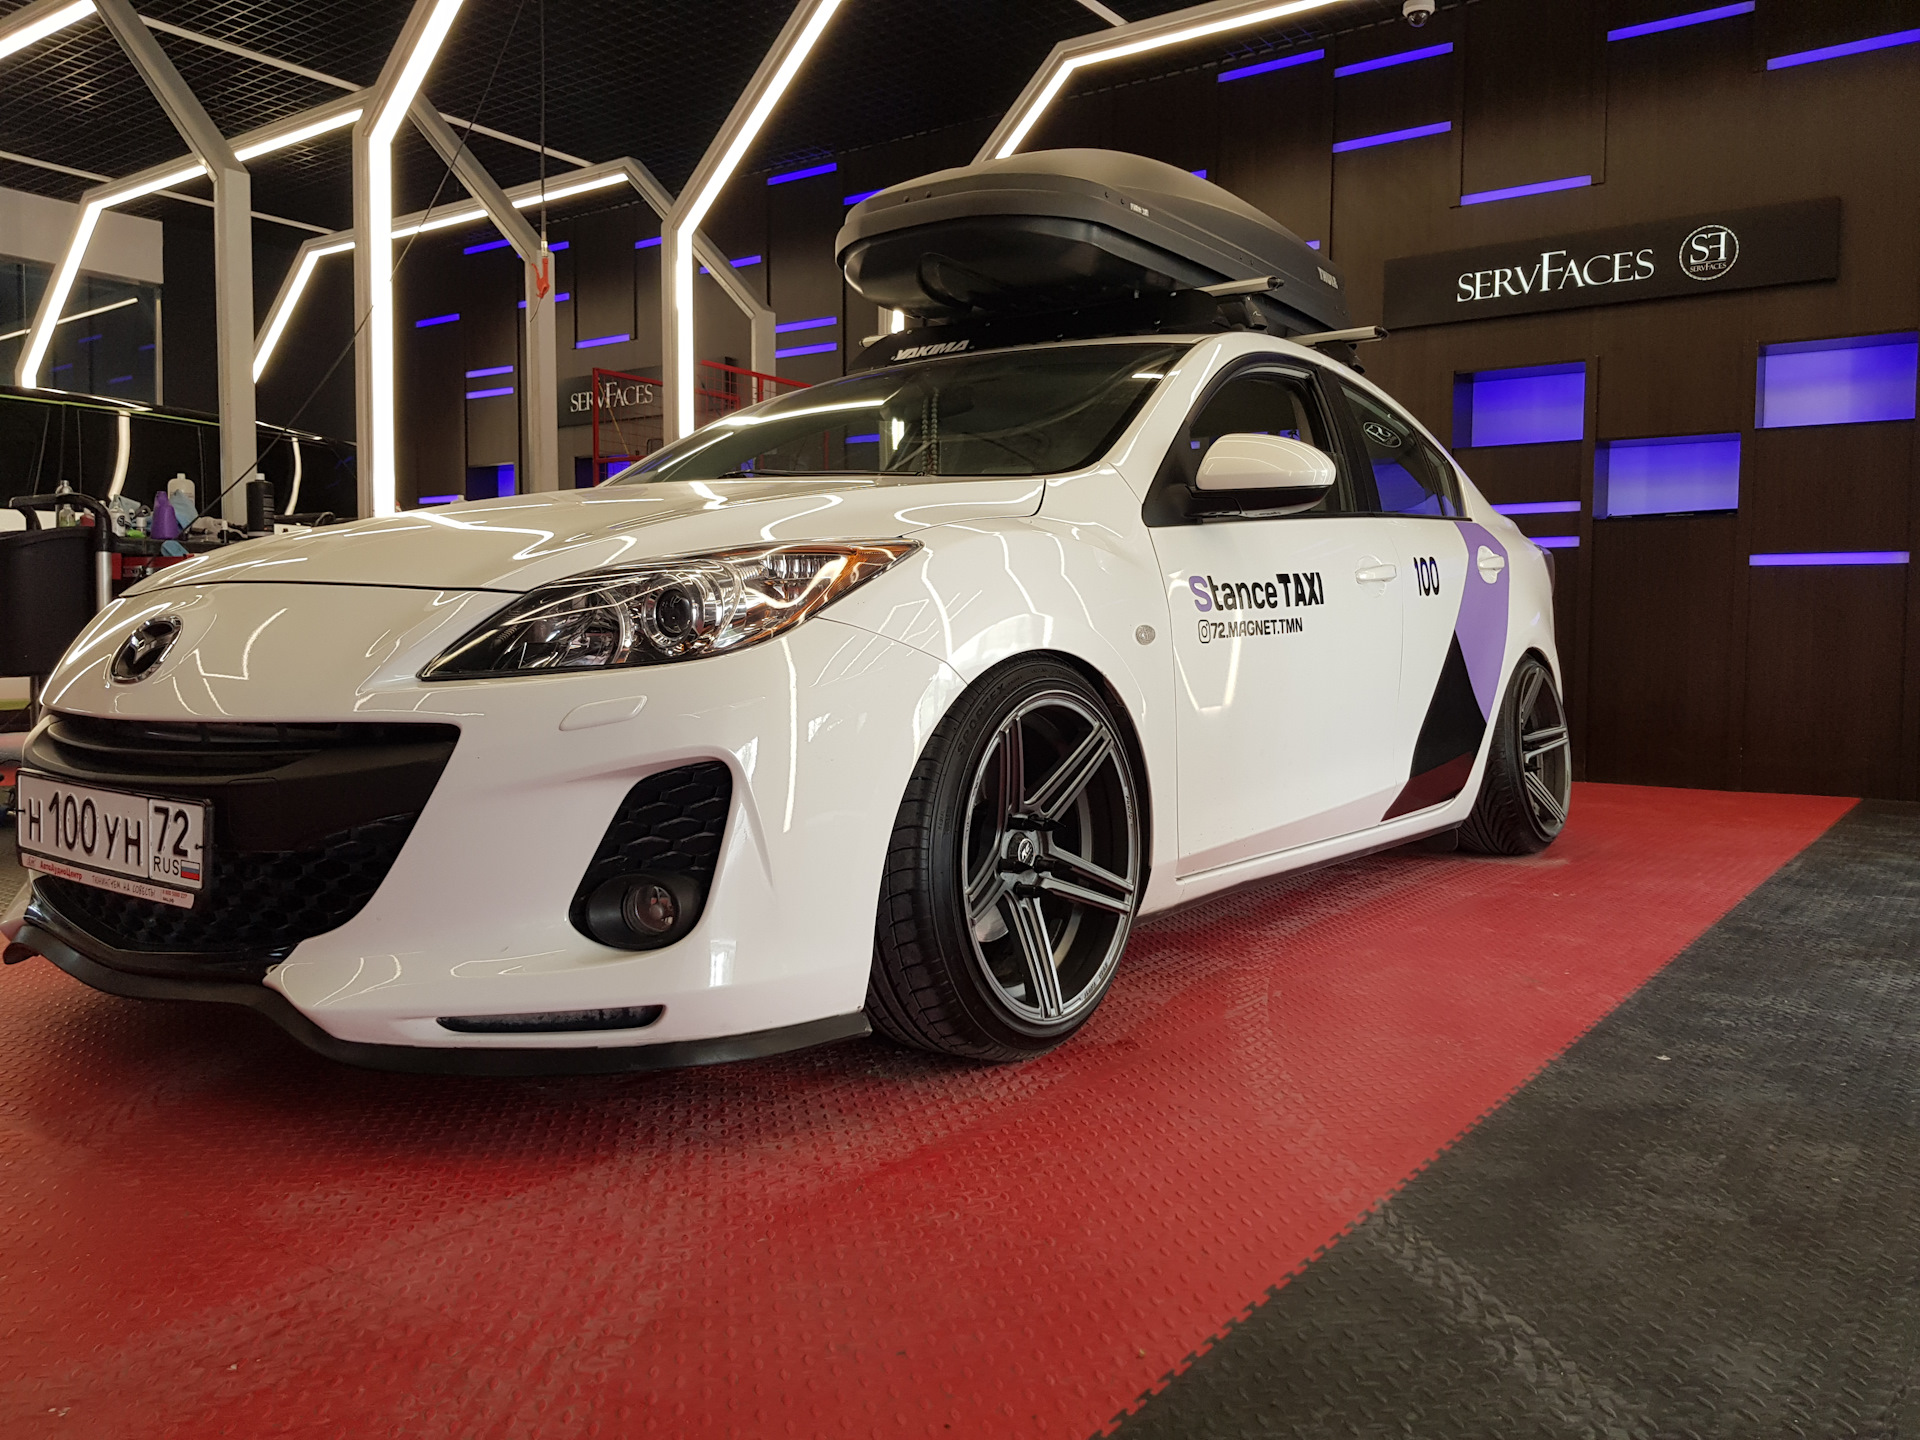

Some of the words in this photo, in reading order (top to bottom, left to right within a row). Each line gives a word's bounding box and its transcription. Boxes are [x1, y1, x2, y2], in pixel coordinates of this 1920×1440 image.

[1457, 249, 1655, 302] SERVFACES
[893, 339, 969, 361] YAKIMA
[1413, 556, 1440, 597] 100
[153, 855, 180, 876] RUS
